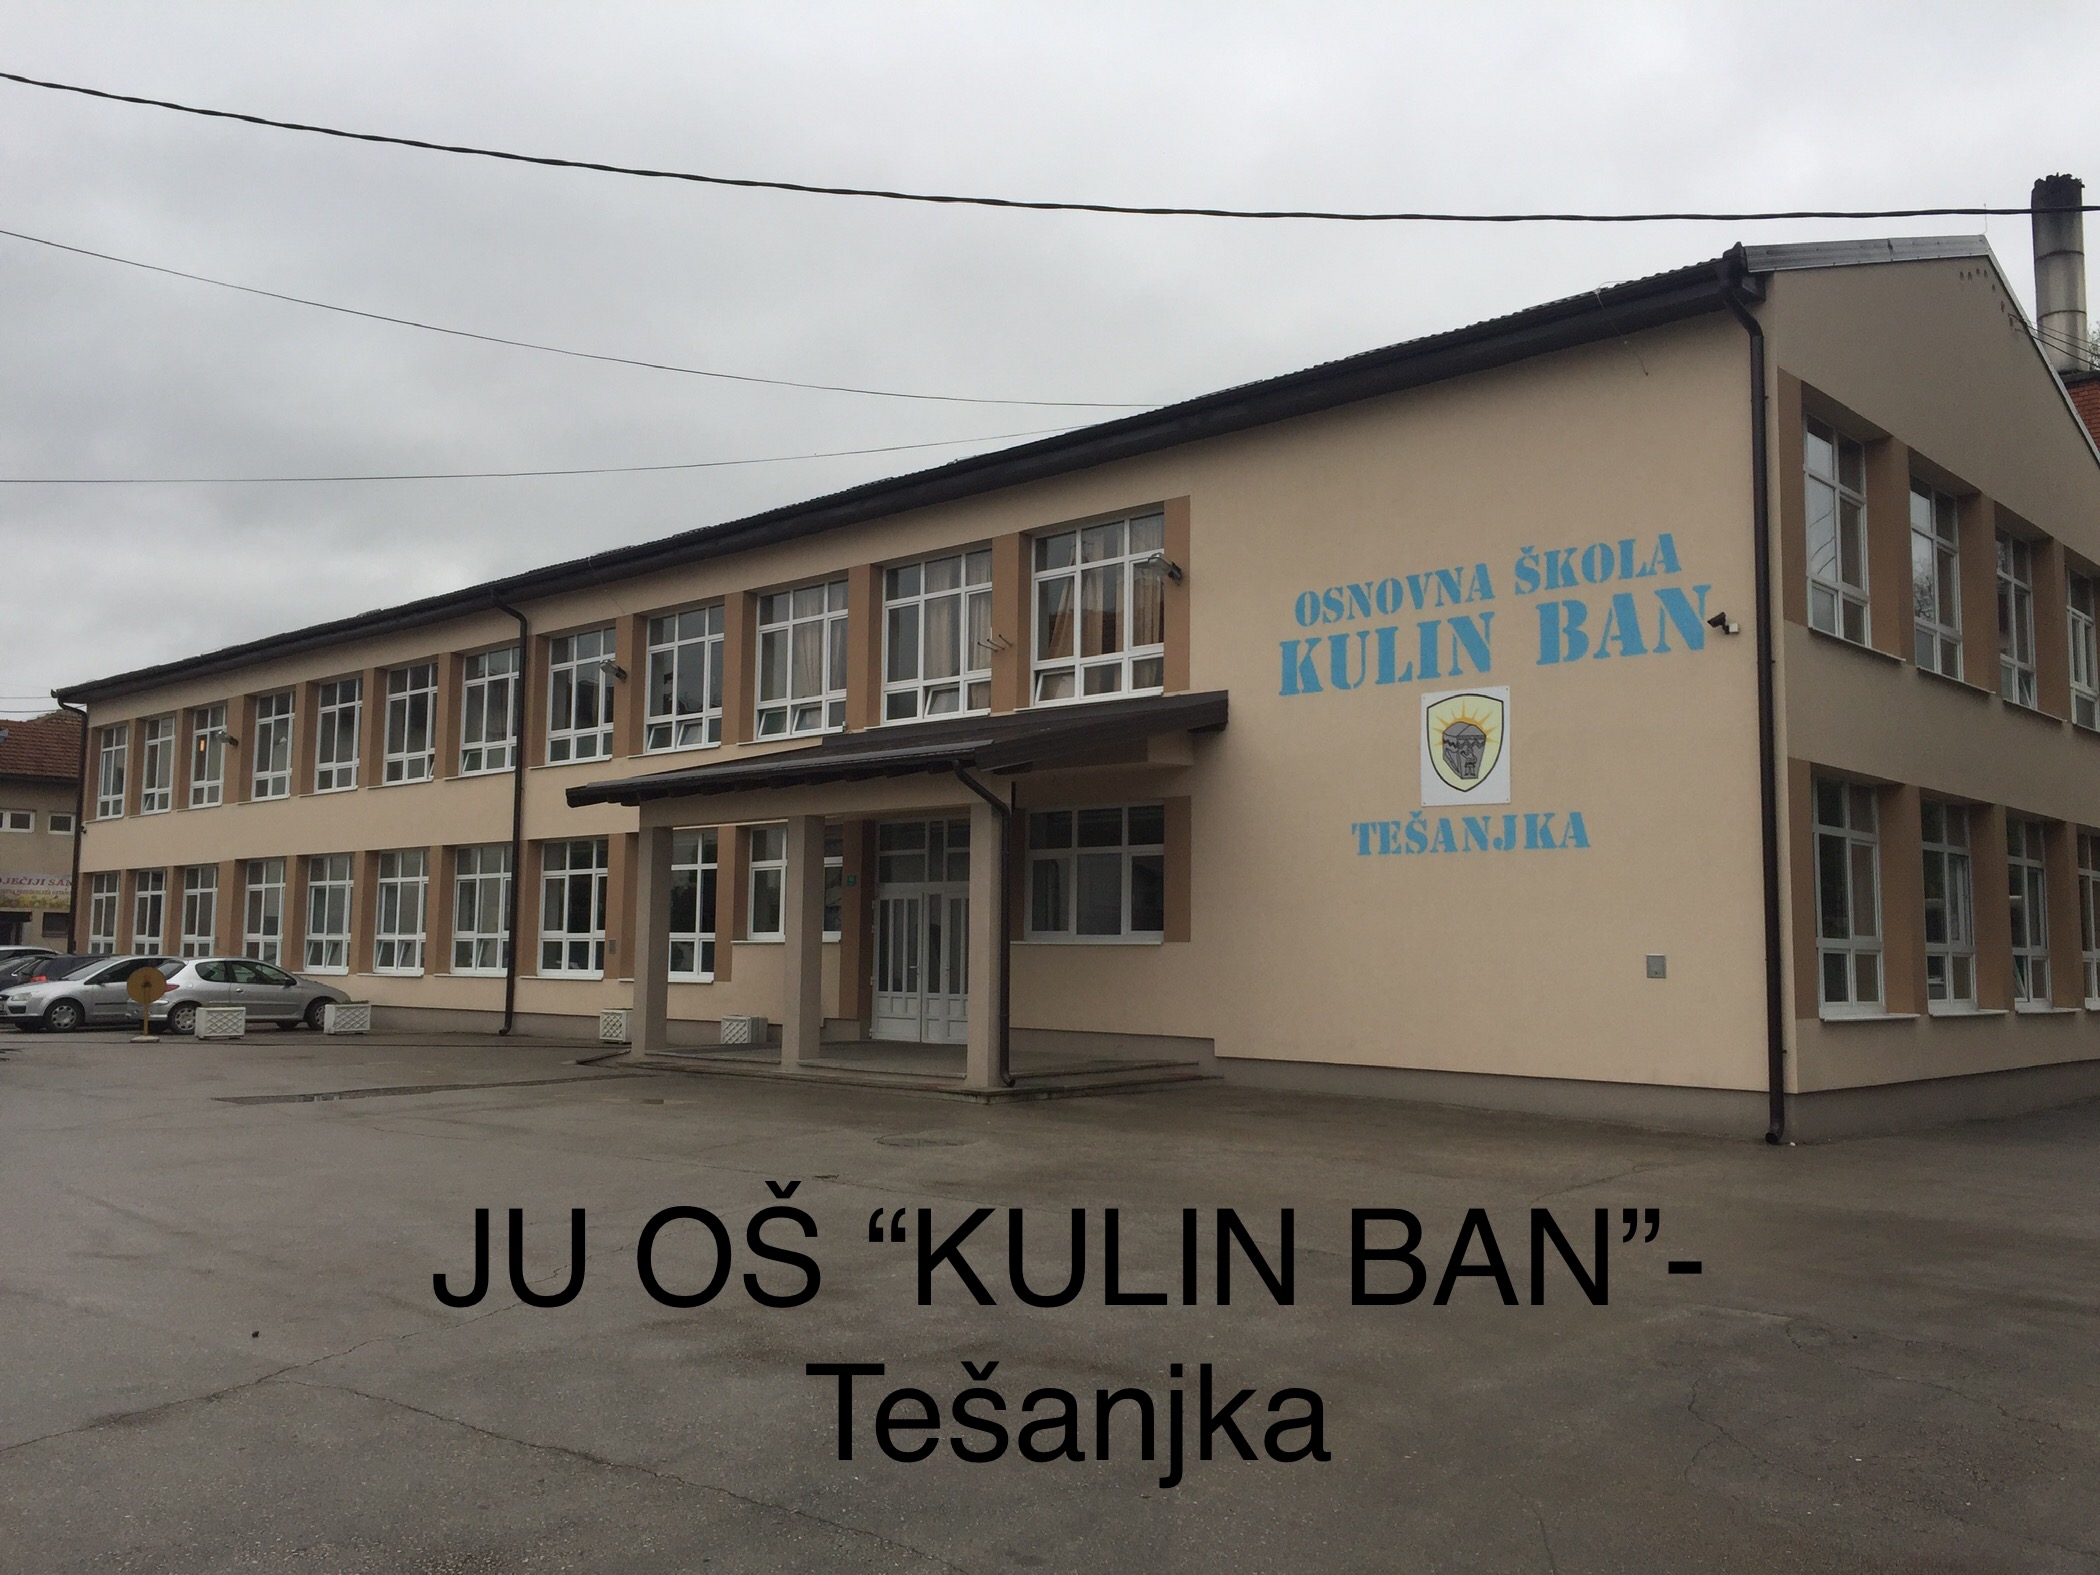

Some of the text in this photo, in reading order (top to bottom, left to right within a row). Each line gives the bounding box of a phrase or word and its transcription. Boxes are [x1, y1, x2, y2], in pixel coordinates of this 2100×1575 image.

[1294, 533, 1682, 628] OSNOVNA ŠKOLA
[1278, 583, 1712, 697] KULIN BAN
[1351, 810, 1591, 857] TEŠANJKA
[0, 876, 46, 886] JEČIJI
